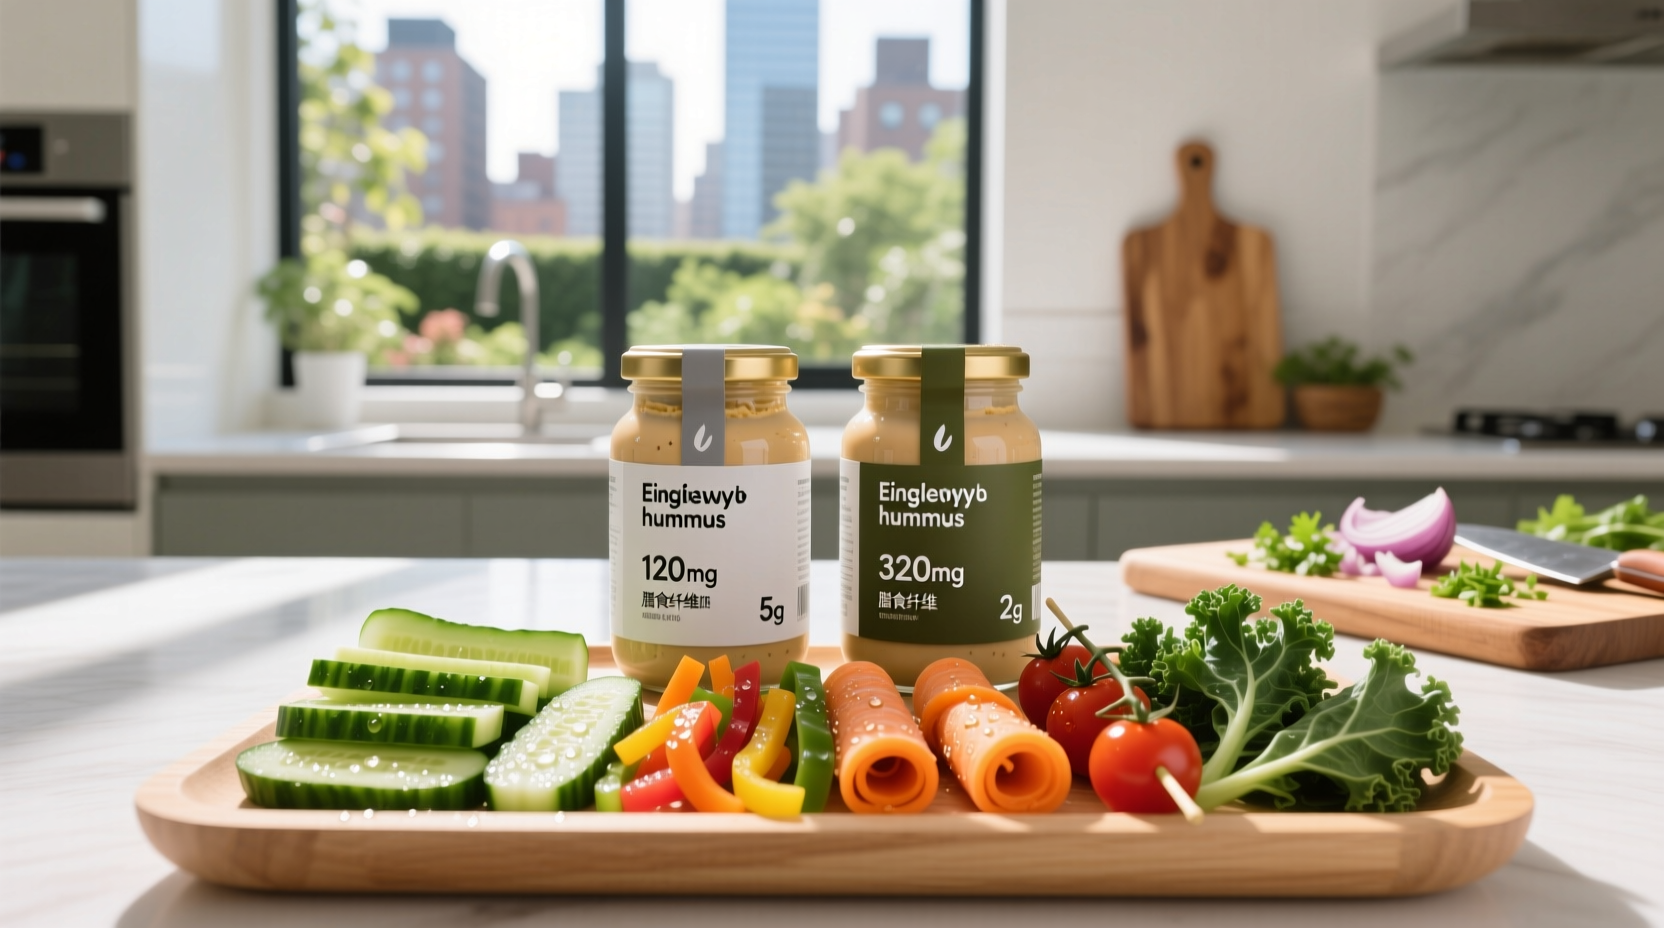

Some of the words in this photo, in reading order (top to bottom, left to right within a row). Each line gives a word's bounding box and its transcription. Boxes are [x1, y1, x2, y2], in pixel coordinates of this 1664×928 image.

[642, 506, 727, 529] hummus
[879, 504, 966, 528] hummus
[641, 554, 718, 589] 120mg
[878, 553, 965, 588] 320mg
[759, 595, 785, 626] 5g
[999, 594, 1023, 625] 2g
